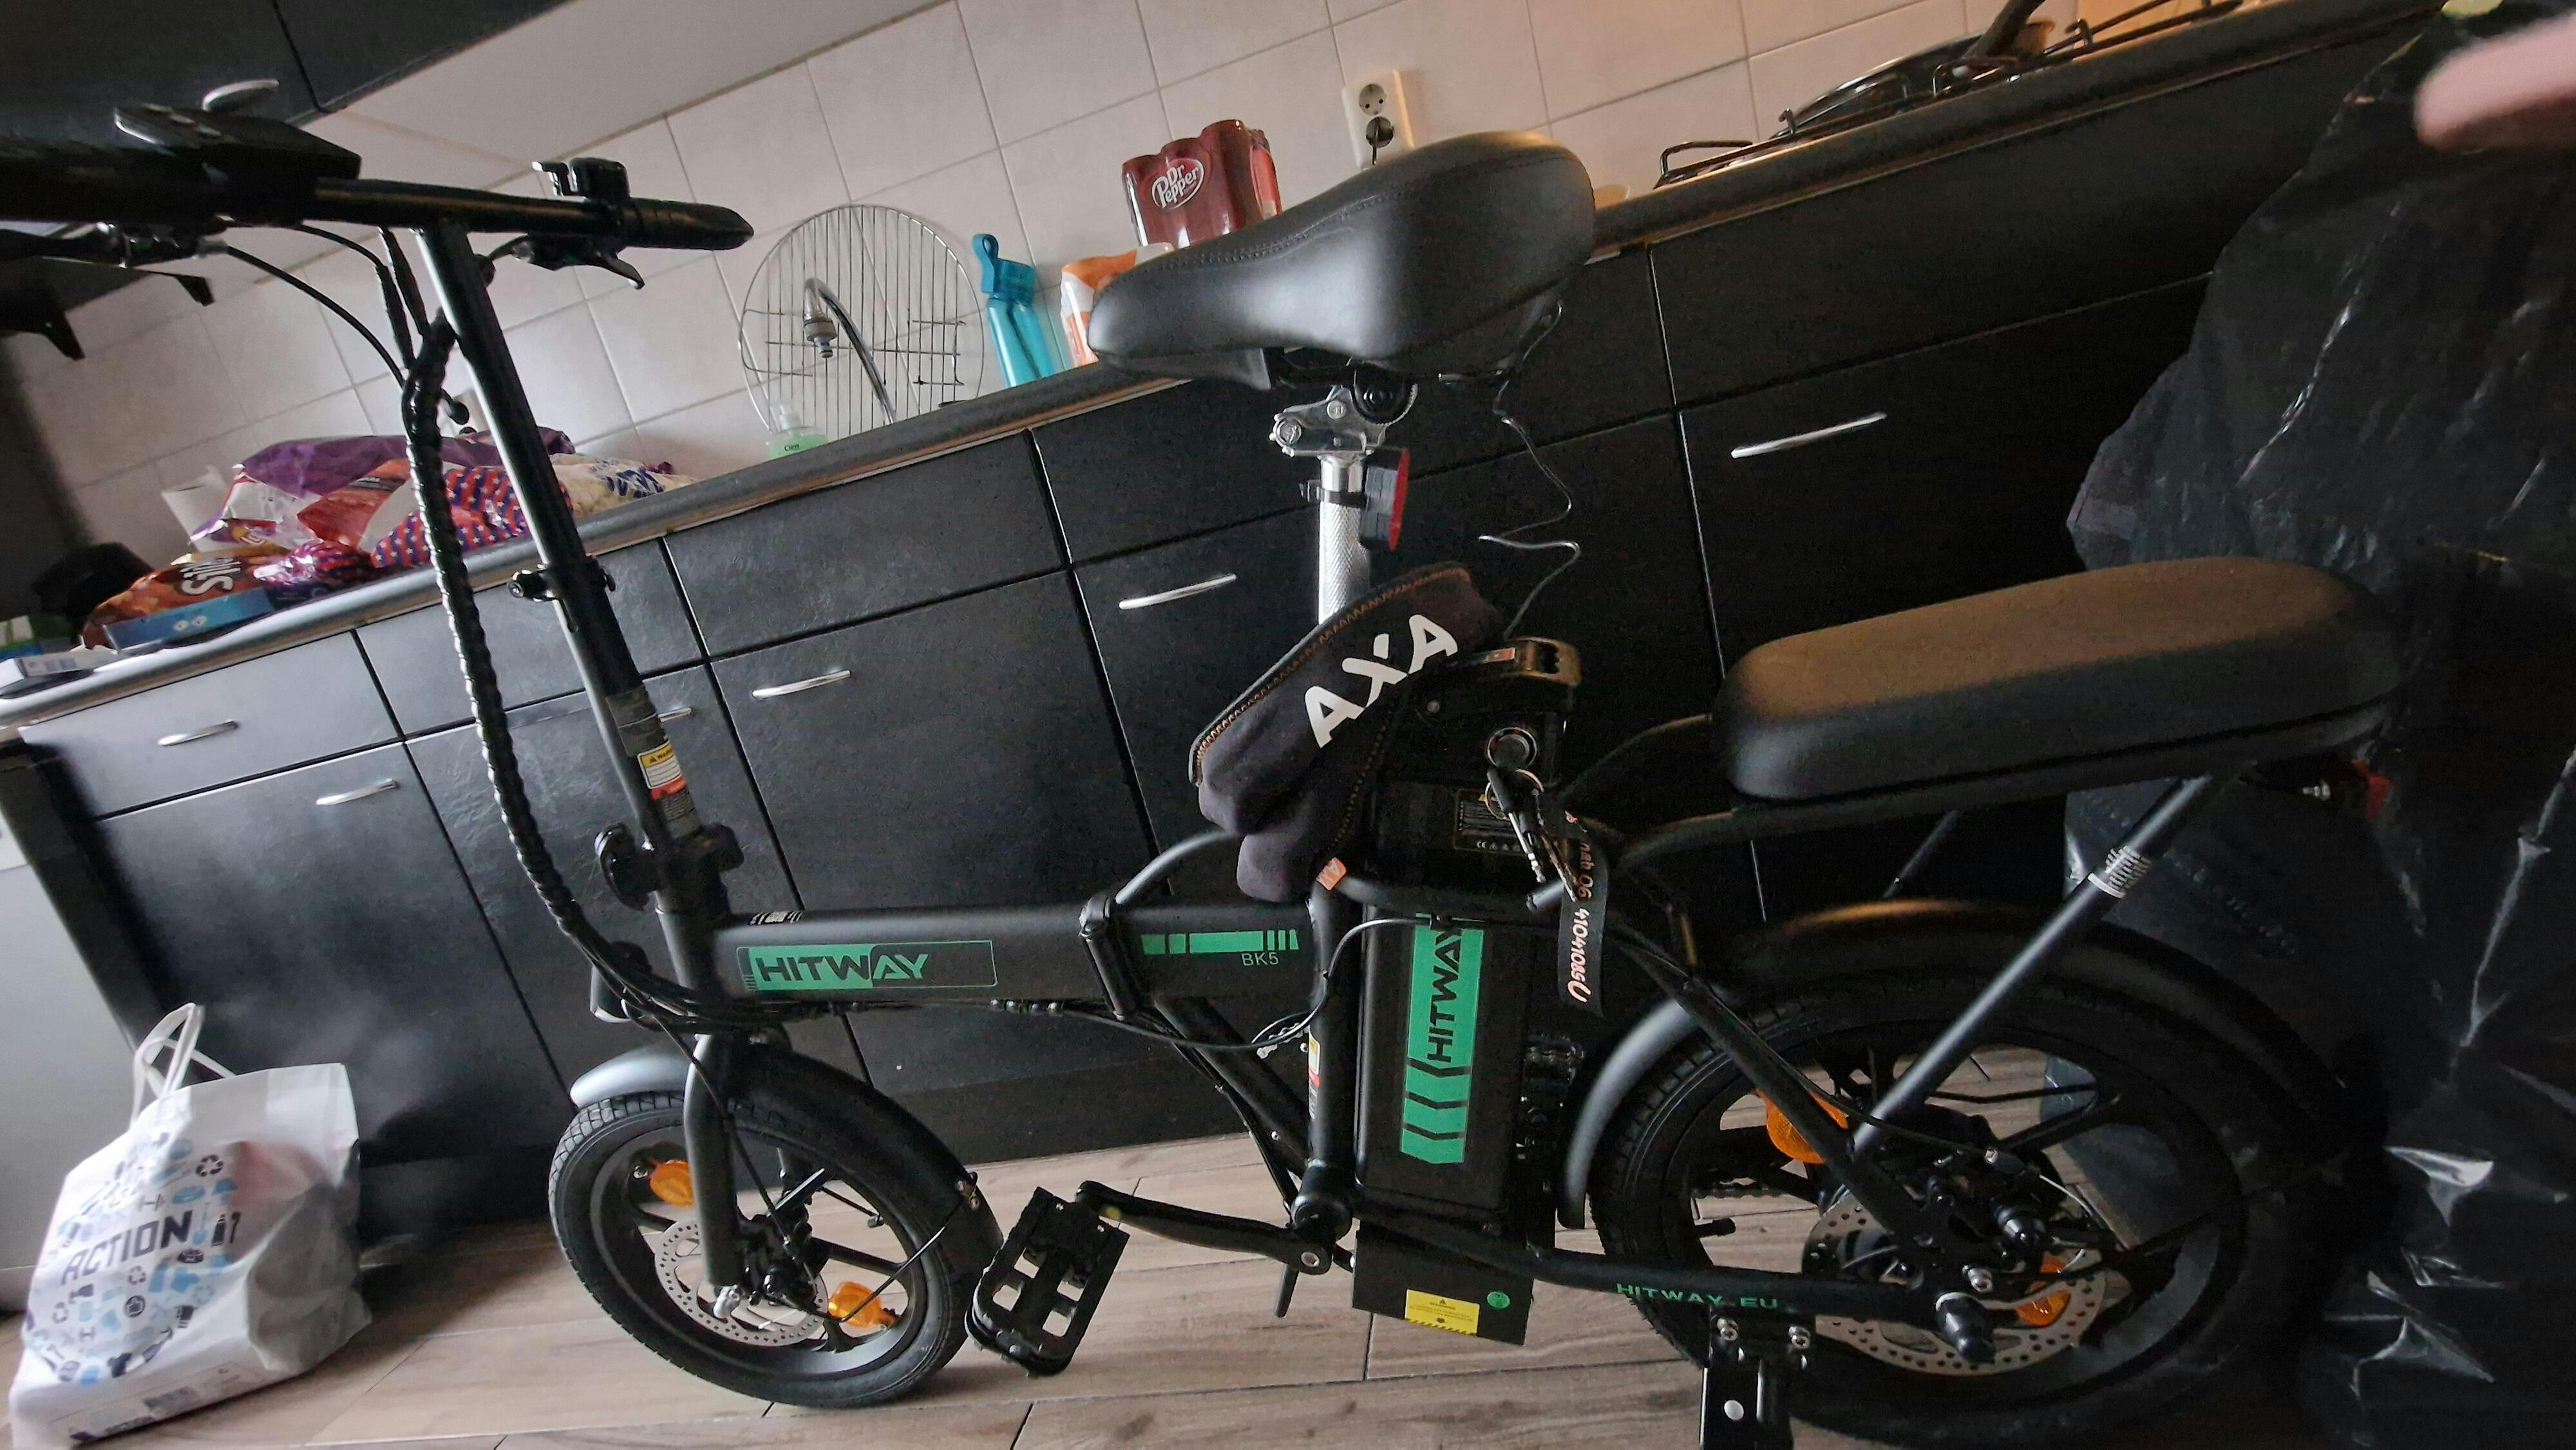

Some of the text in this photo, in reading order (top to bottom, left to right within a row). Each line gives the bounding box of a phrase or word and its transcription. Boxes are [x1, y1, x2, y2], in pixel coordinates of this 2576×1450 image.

[1152, 167, 1200, 209] Pepper
[1166, 165, 1185, 187] Dr
[1305, 614, 1458, 748] AXA
[755, 954, 929, 982] HITWAY
[1241, 952, 1279, 966] BK5
[61, 1210, 193, 1285] ACTION
